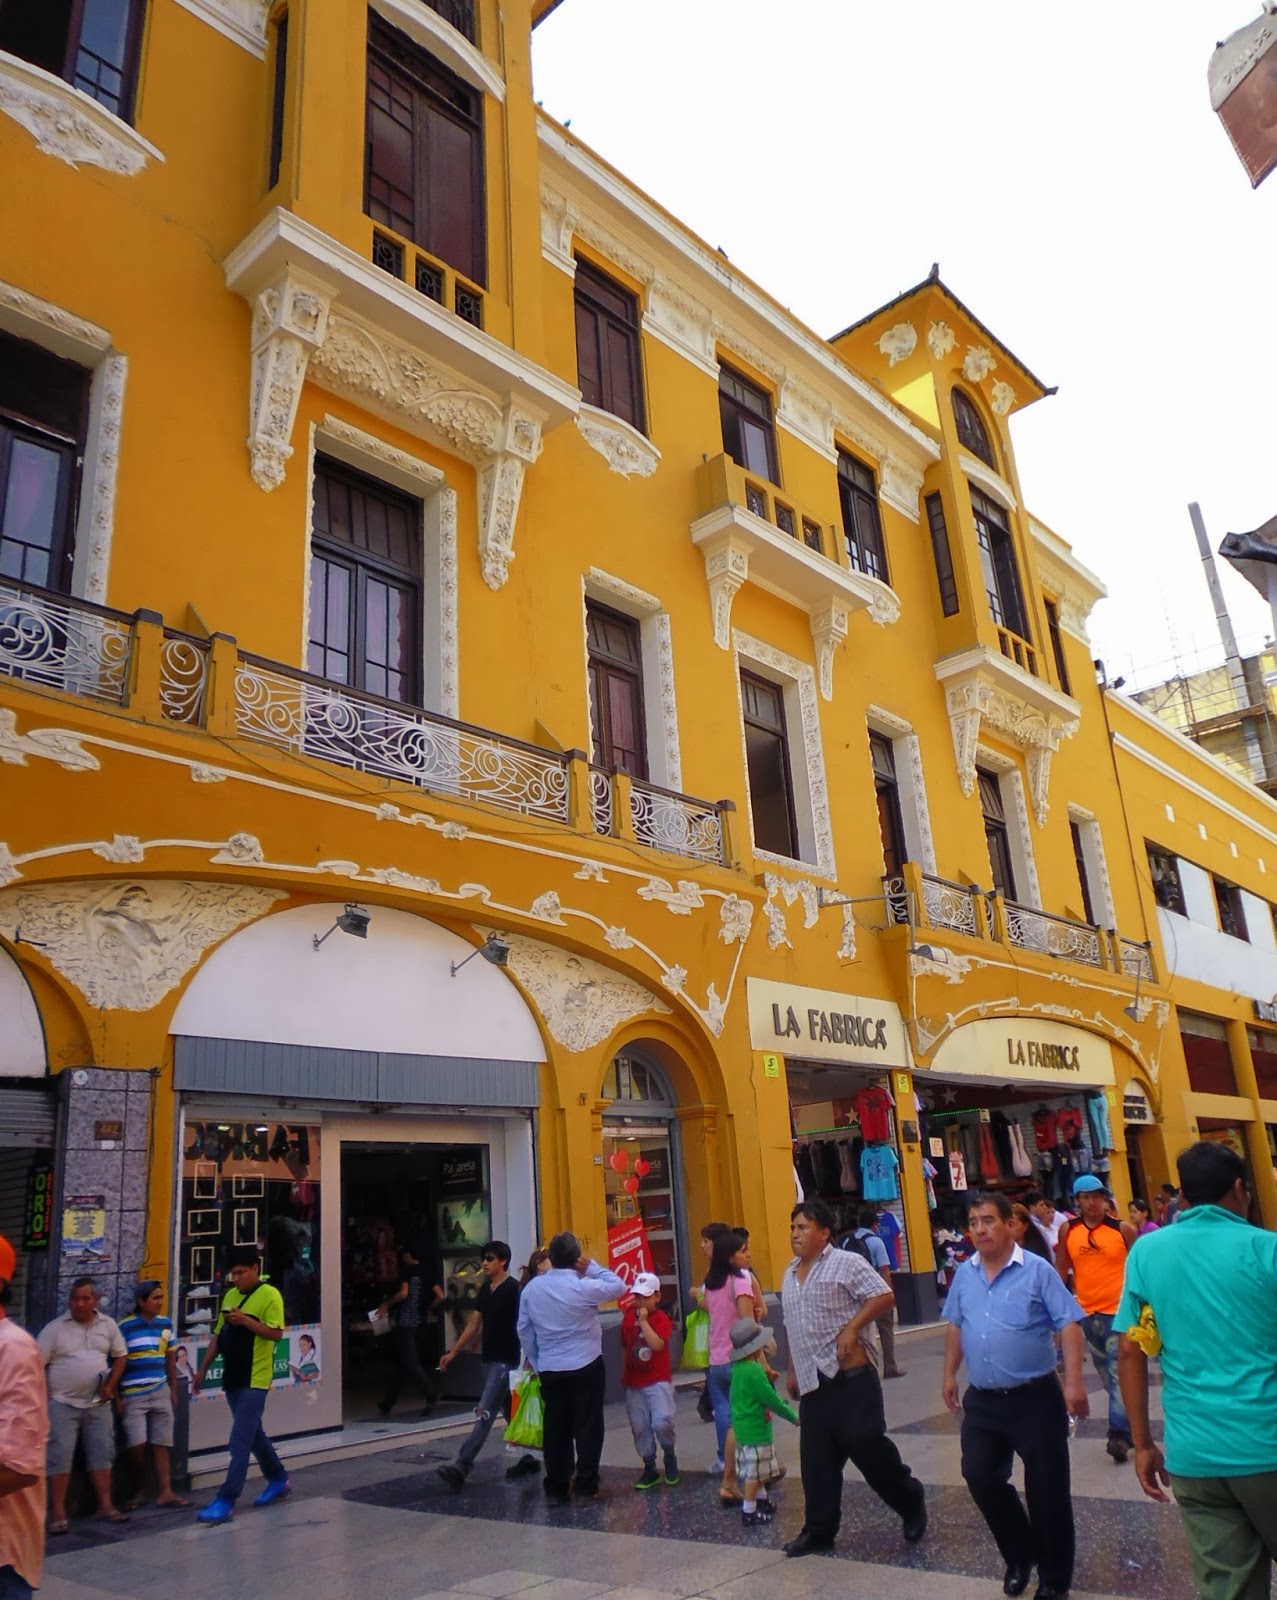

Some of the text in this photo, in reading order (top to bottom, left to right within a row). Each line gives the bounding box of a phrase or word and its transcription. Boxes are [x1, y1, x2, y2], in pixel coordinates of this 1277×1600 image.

[772, 1003, 887, 1050] LA FABRICA
[1007, 1038, 1080, 1072] LA FABRICA
[33, 1173, 46, 1232] ORO
